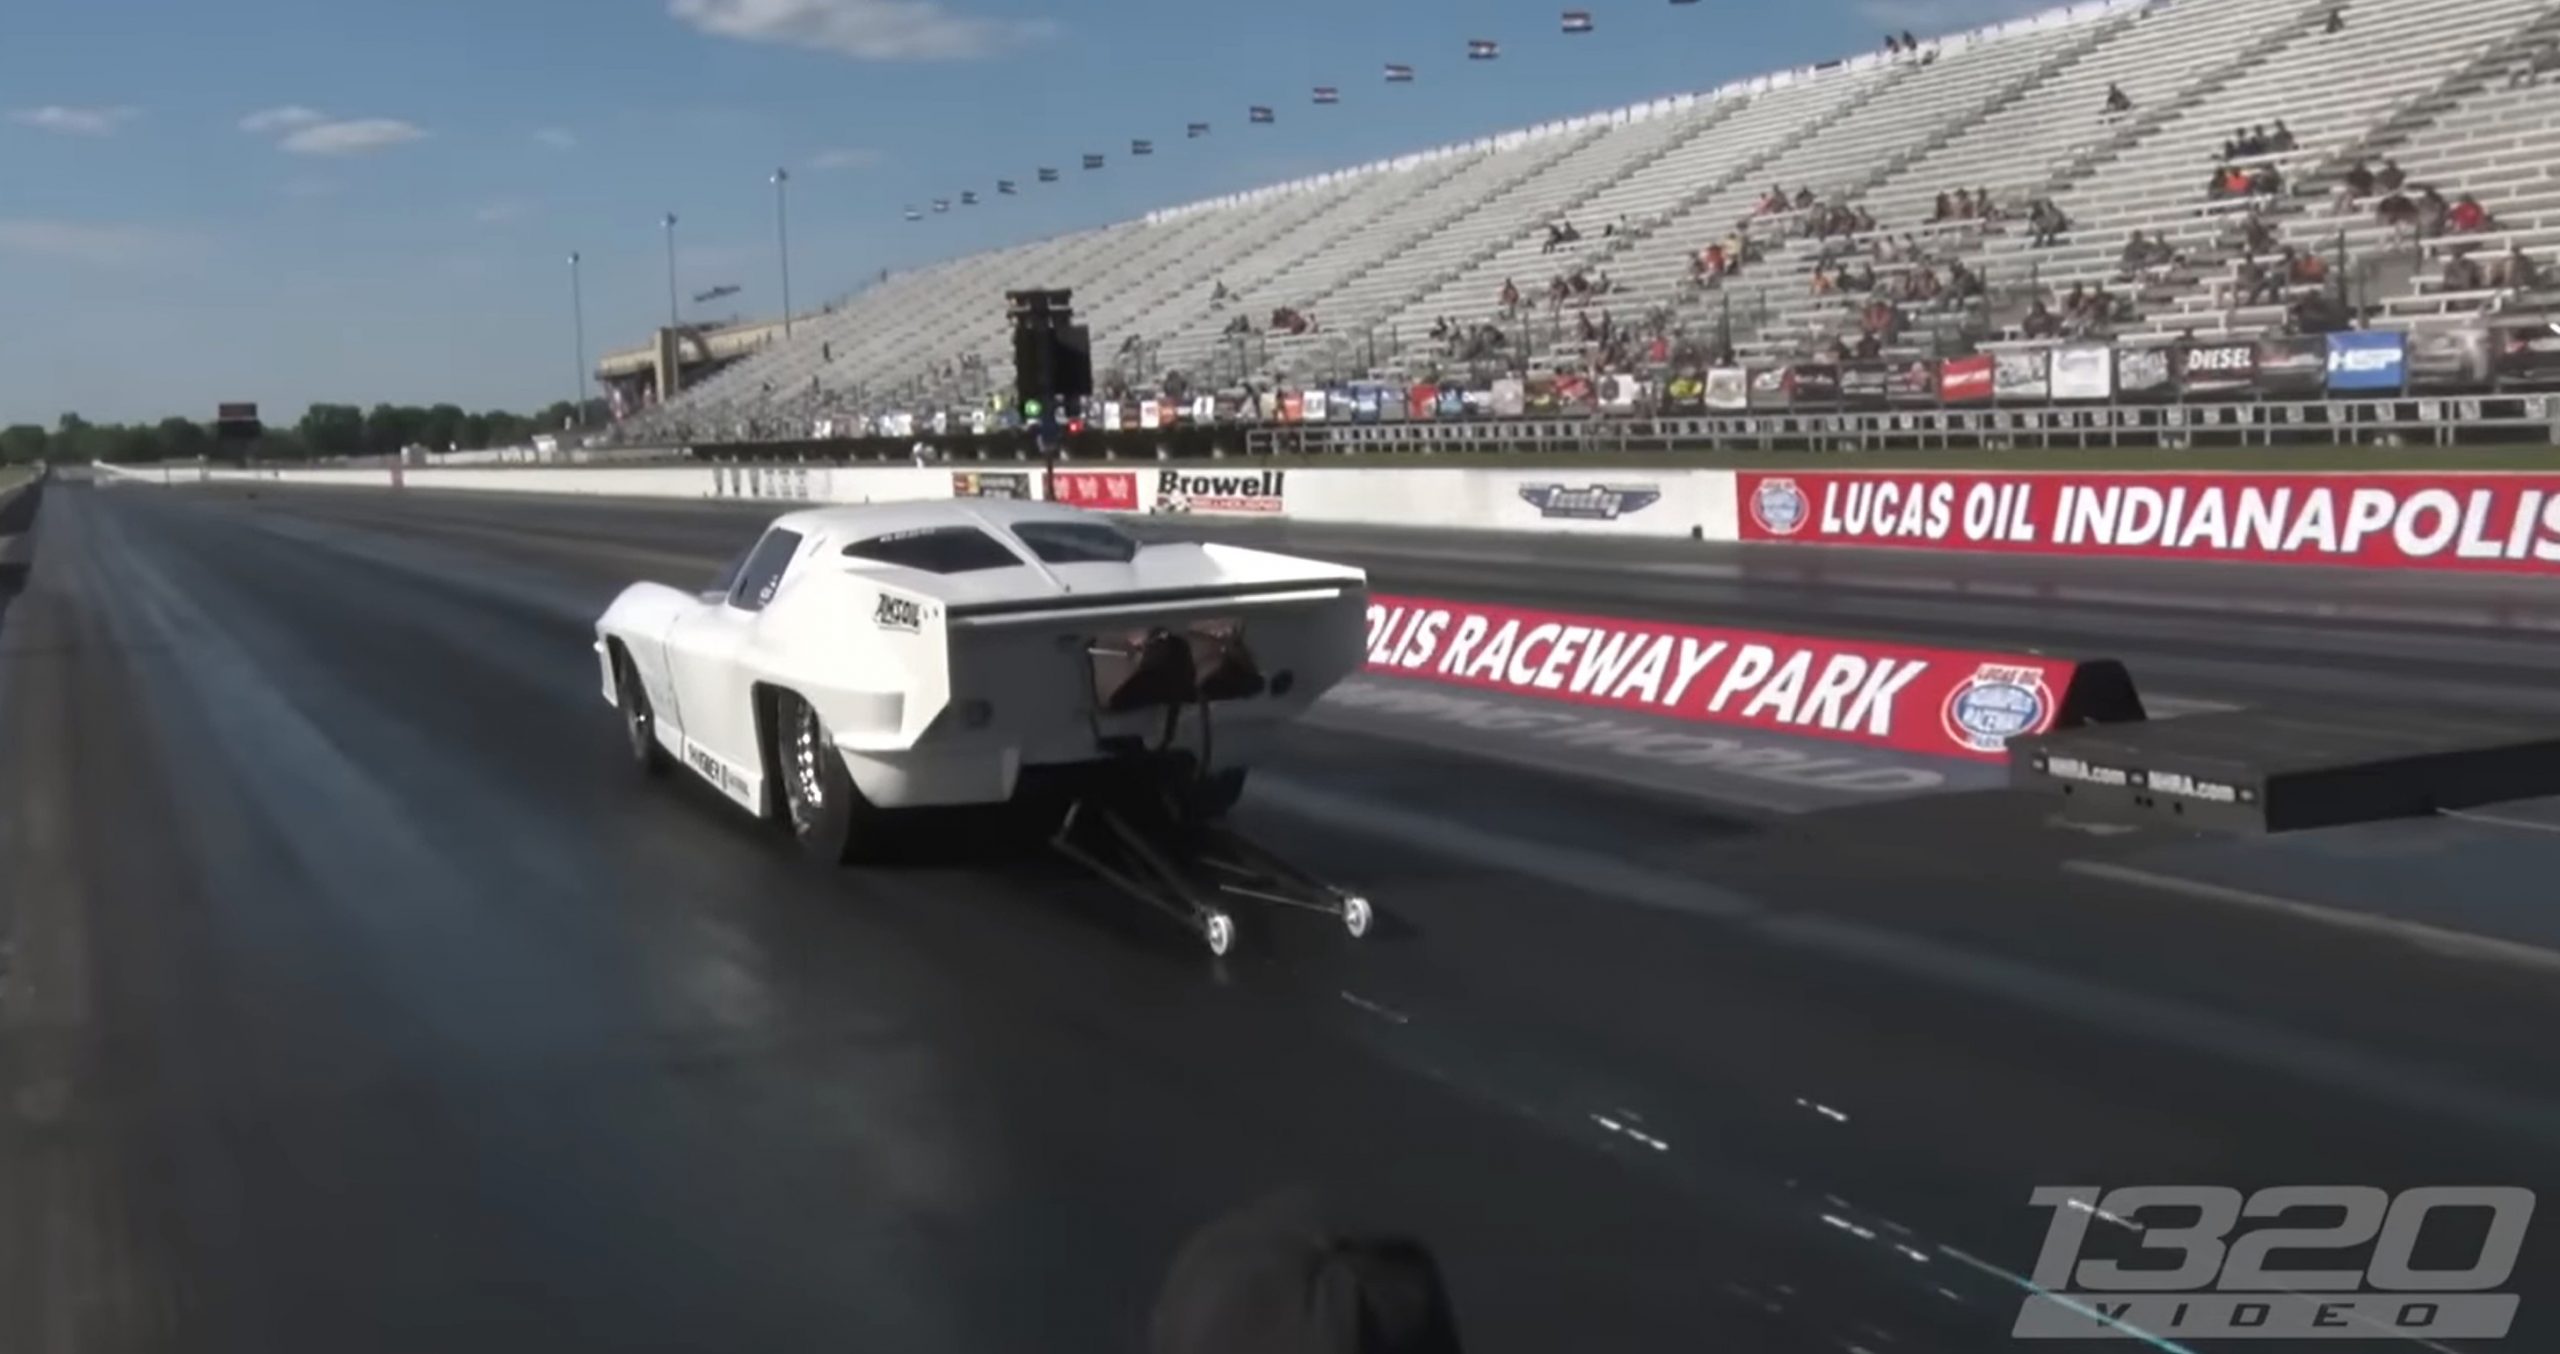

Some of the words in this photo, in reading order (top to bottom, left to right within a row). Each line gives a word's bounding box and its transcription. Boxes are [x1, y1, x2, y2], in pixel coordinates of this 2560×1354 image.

[2187, 347, 2252, 370] DIESEL
[2328, 349, 2402, 371] HSP
[1158, 470, 1284, 497] Browell
[1821, 481, 1954, 539] LUCAS
[1963, 482, 2036, 542] OIL
[1437, 614, 1727, 707] RACEWAY
[1707, 645, 1928, 737] PARK
[2048, 756, 2127, 786] NHRA.com
[2148, 770, 2236, 802] NHRA.com
